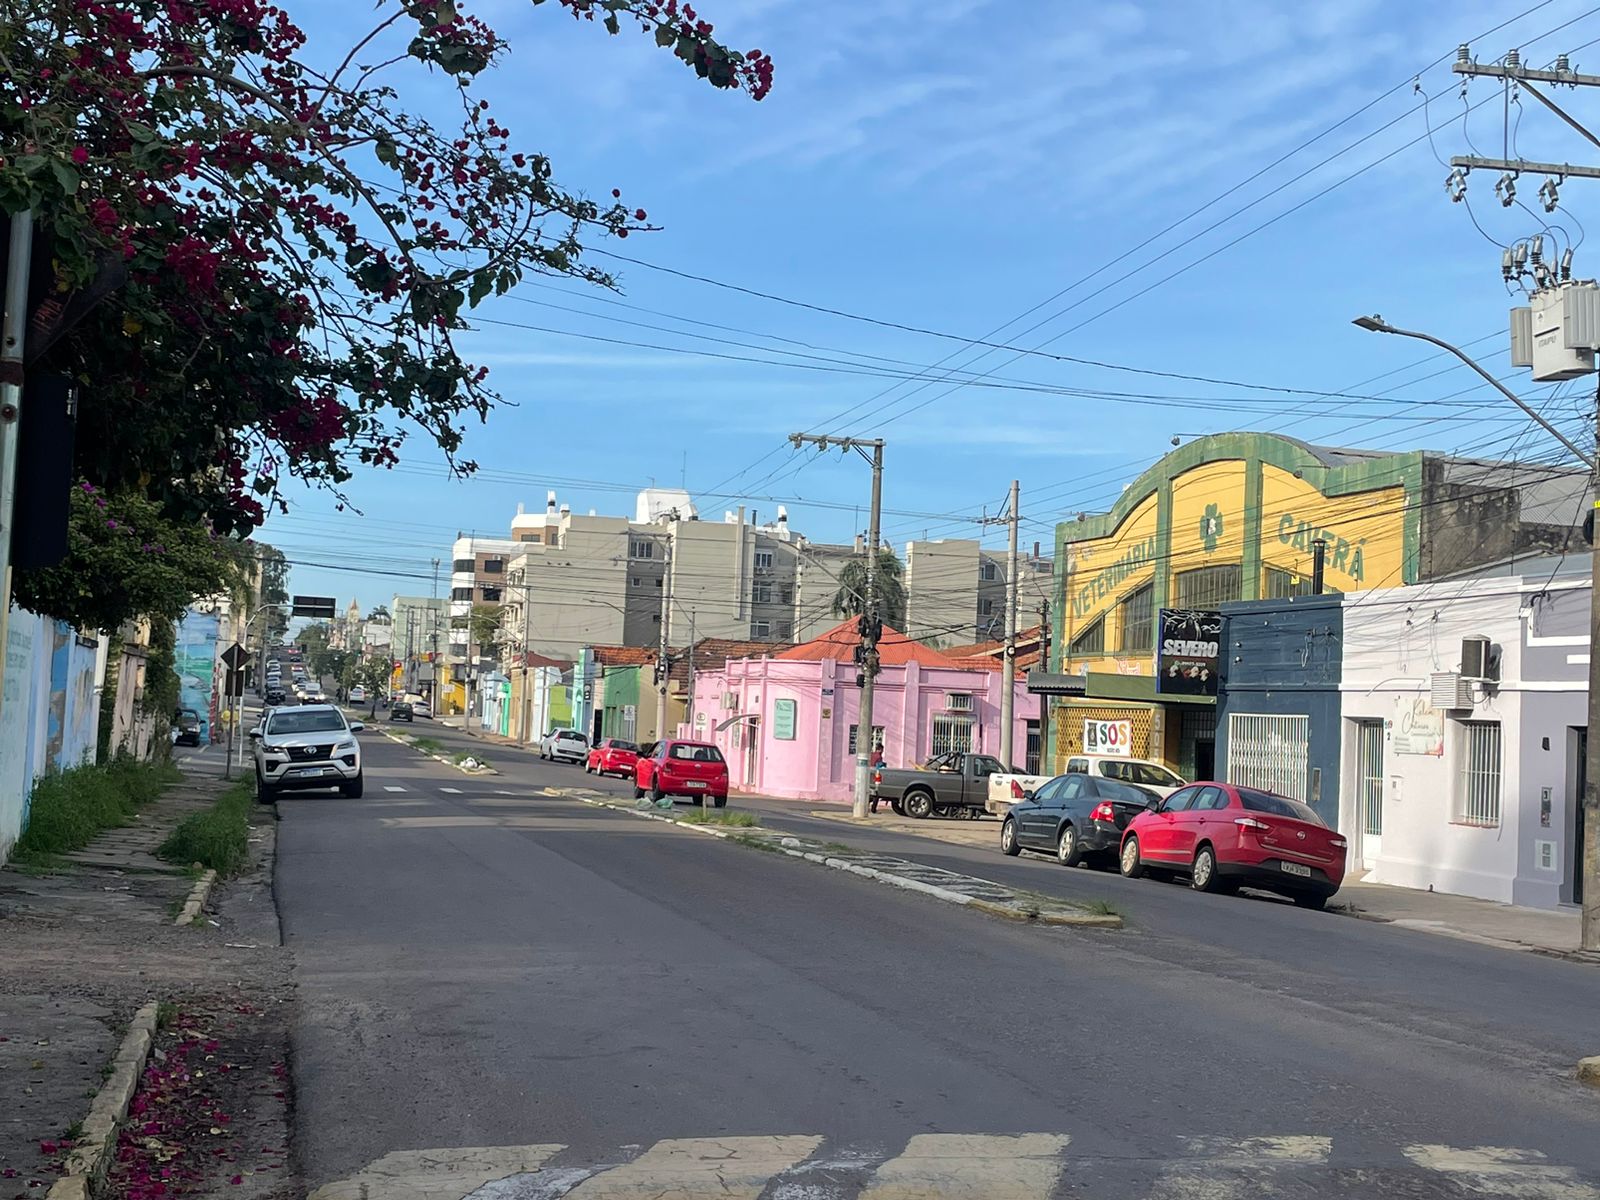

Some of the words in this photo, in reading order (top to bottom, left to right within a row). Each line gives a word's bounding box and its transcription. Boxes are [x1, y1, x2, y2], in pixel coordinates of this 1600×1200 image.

[1072, 536, 1156, 618] VETERINÁRIA
[1278, 513, 1367, 582] CAVERÁ
[1163, 639, 1218, 658] SEVERO
[1100, 723, 1127, 745] SOS
